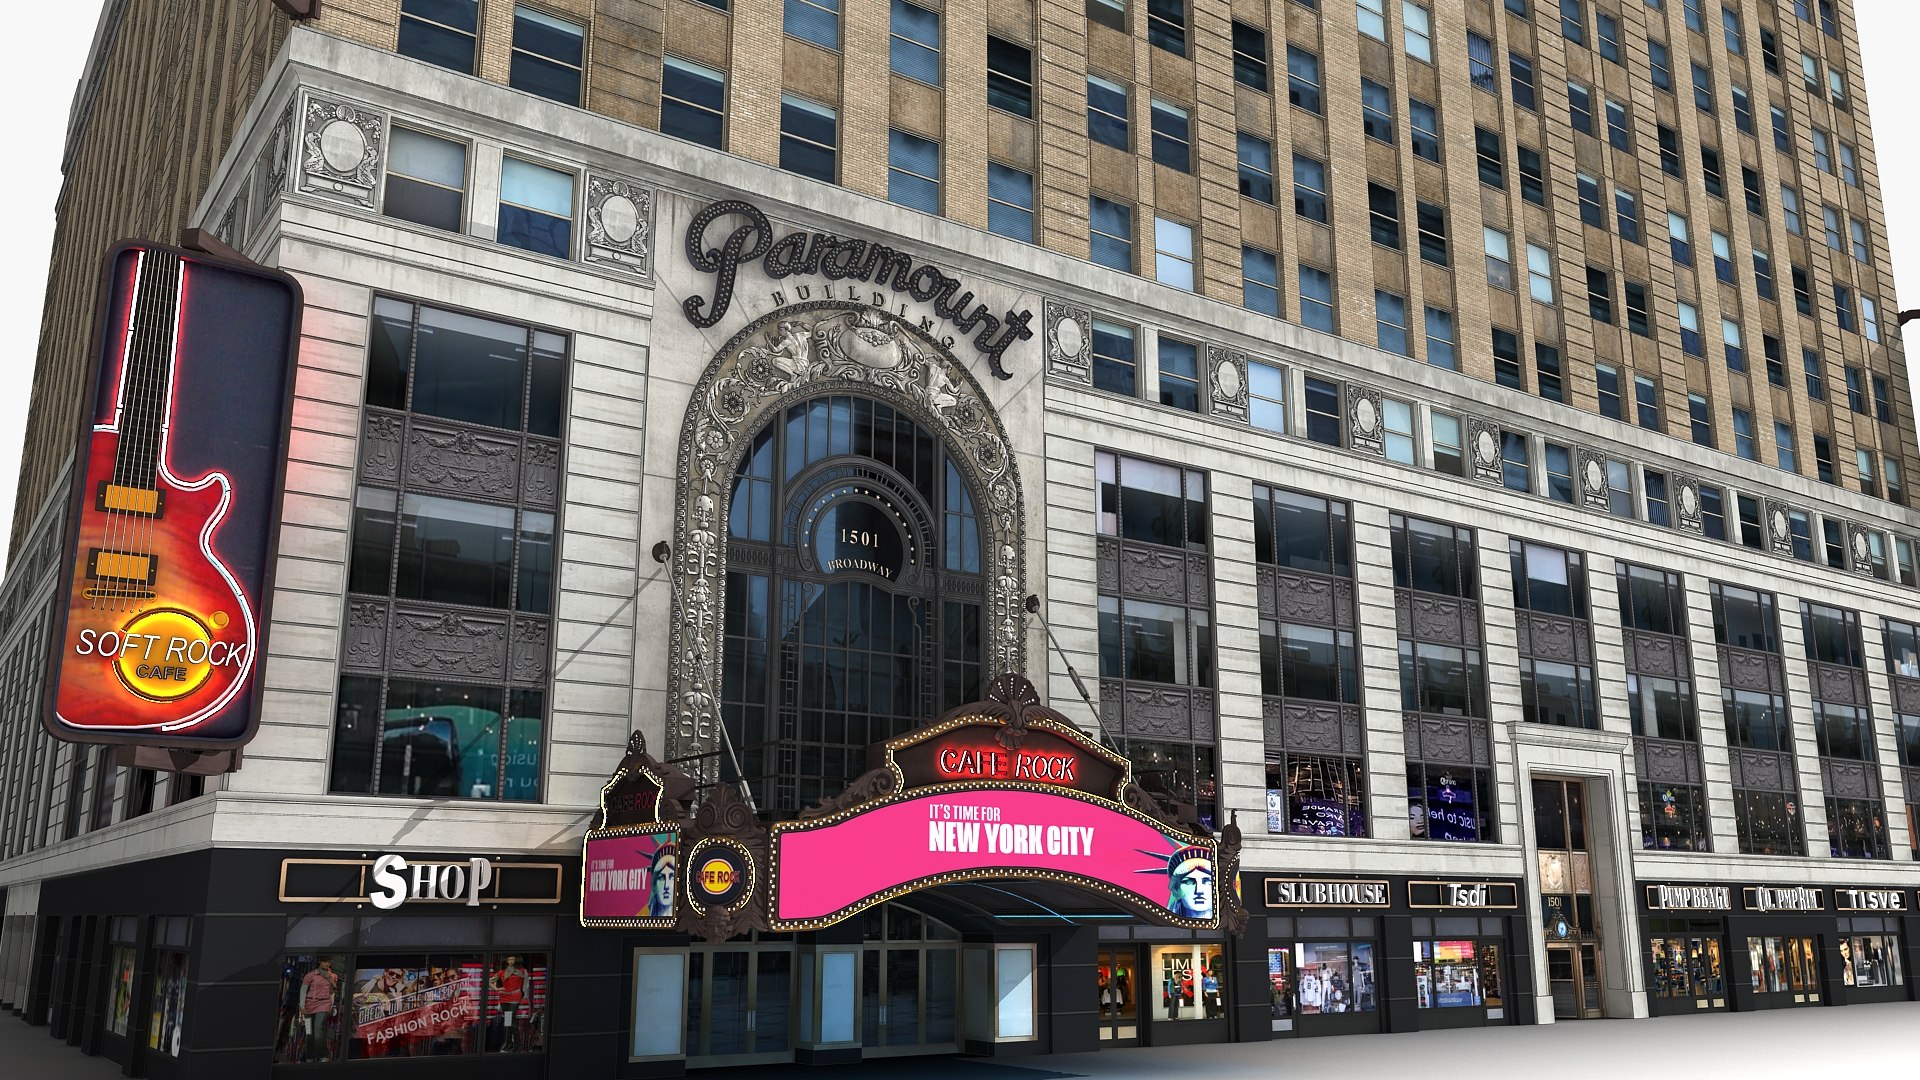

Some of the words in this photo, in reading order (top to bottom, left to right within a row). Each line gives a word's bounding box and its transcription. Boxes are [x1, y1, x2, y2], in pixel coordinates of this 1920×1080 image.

[682, 200, 1034, 382] Paramount
[771, 284, 956, 351] BUILDING
[841, 528, 879, 548] 1501
[827, 558, 893, 578] BROADWAY
[75, 629, 161, 660] SOFT
[164, 636, 247, 668] ROCK
[135, 664, 187, 682] CAFE
[1015, 753, 1075, 781] ROCK
[929, 804, 951, 820] IT'S
[953, 805, 979, 821] TIME
[981, 807, 1001, 821] FOR
[929, 820, 980, 853] NEW
[984, 823, 1043, 855] YORK
[1047, 825, 1094, 856] CITY
[369, 854, 492, 909] SHOP
[590, 870, 607, 891] NEW
[608, 869, 629, 891] YORK
[629, 868, 648, 890] CITY
[1278, 882, 1386, 904] SLUBHOUSE
[1448, 883, 1487, 907] Tsdi
[1547, 896, 1562, 907] 1501
[1658, 885, 1690, 909] PUMP
[358, 1003, 386, 1024] CHECK
[366, 1017, 427, 1045] FASHION
[430, 1004, 469, 1025] ROCK
